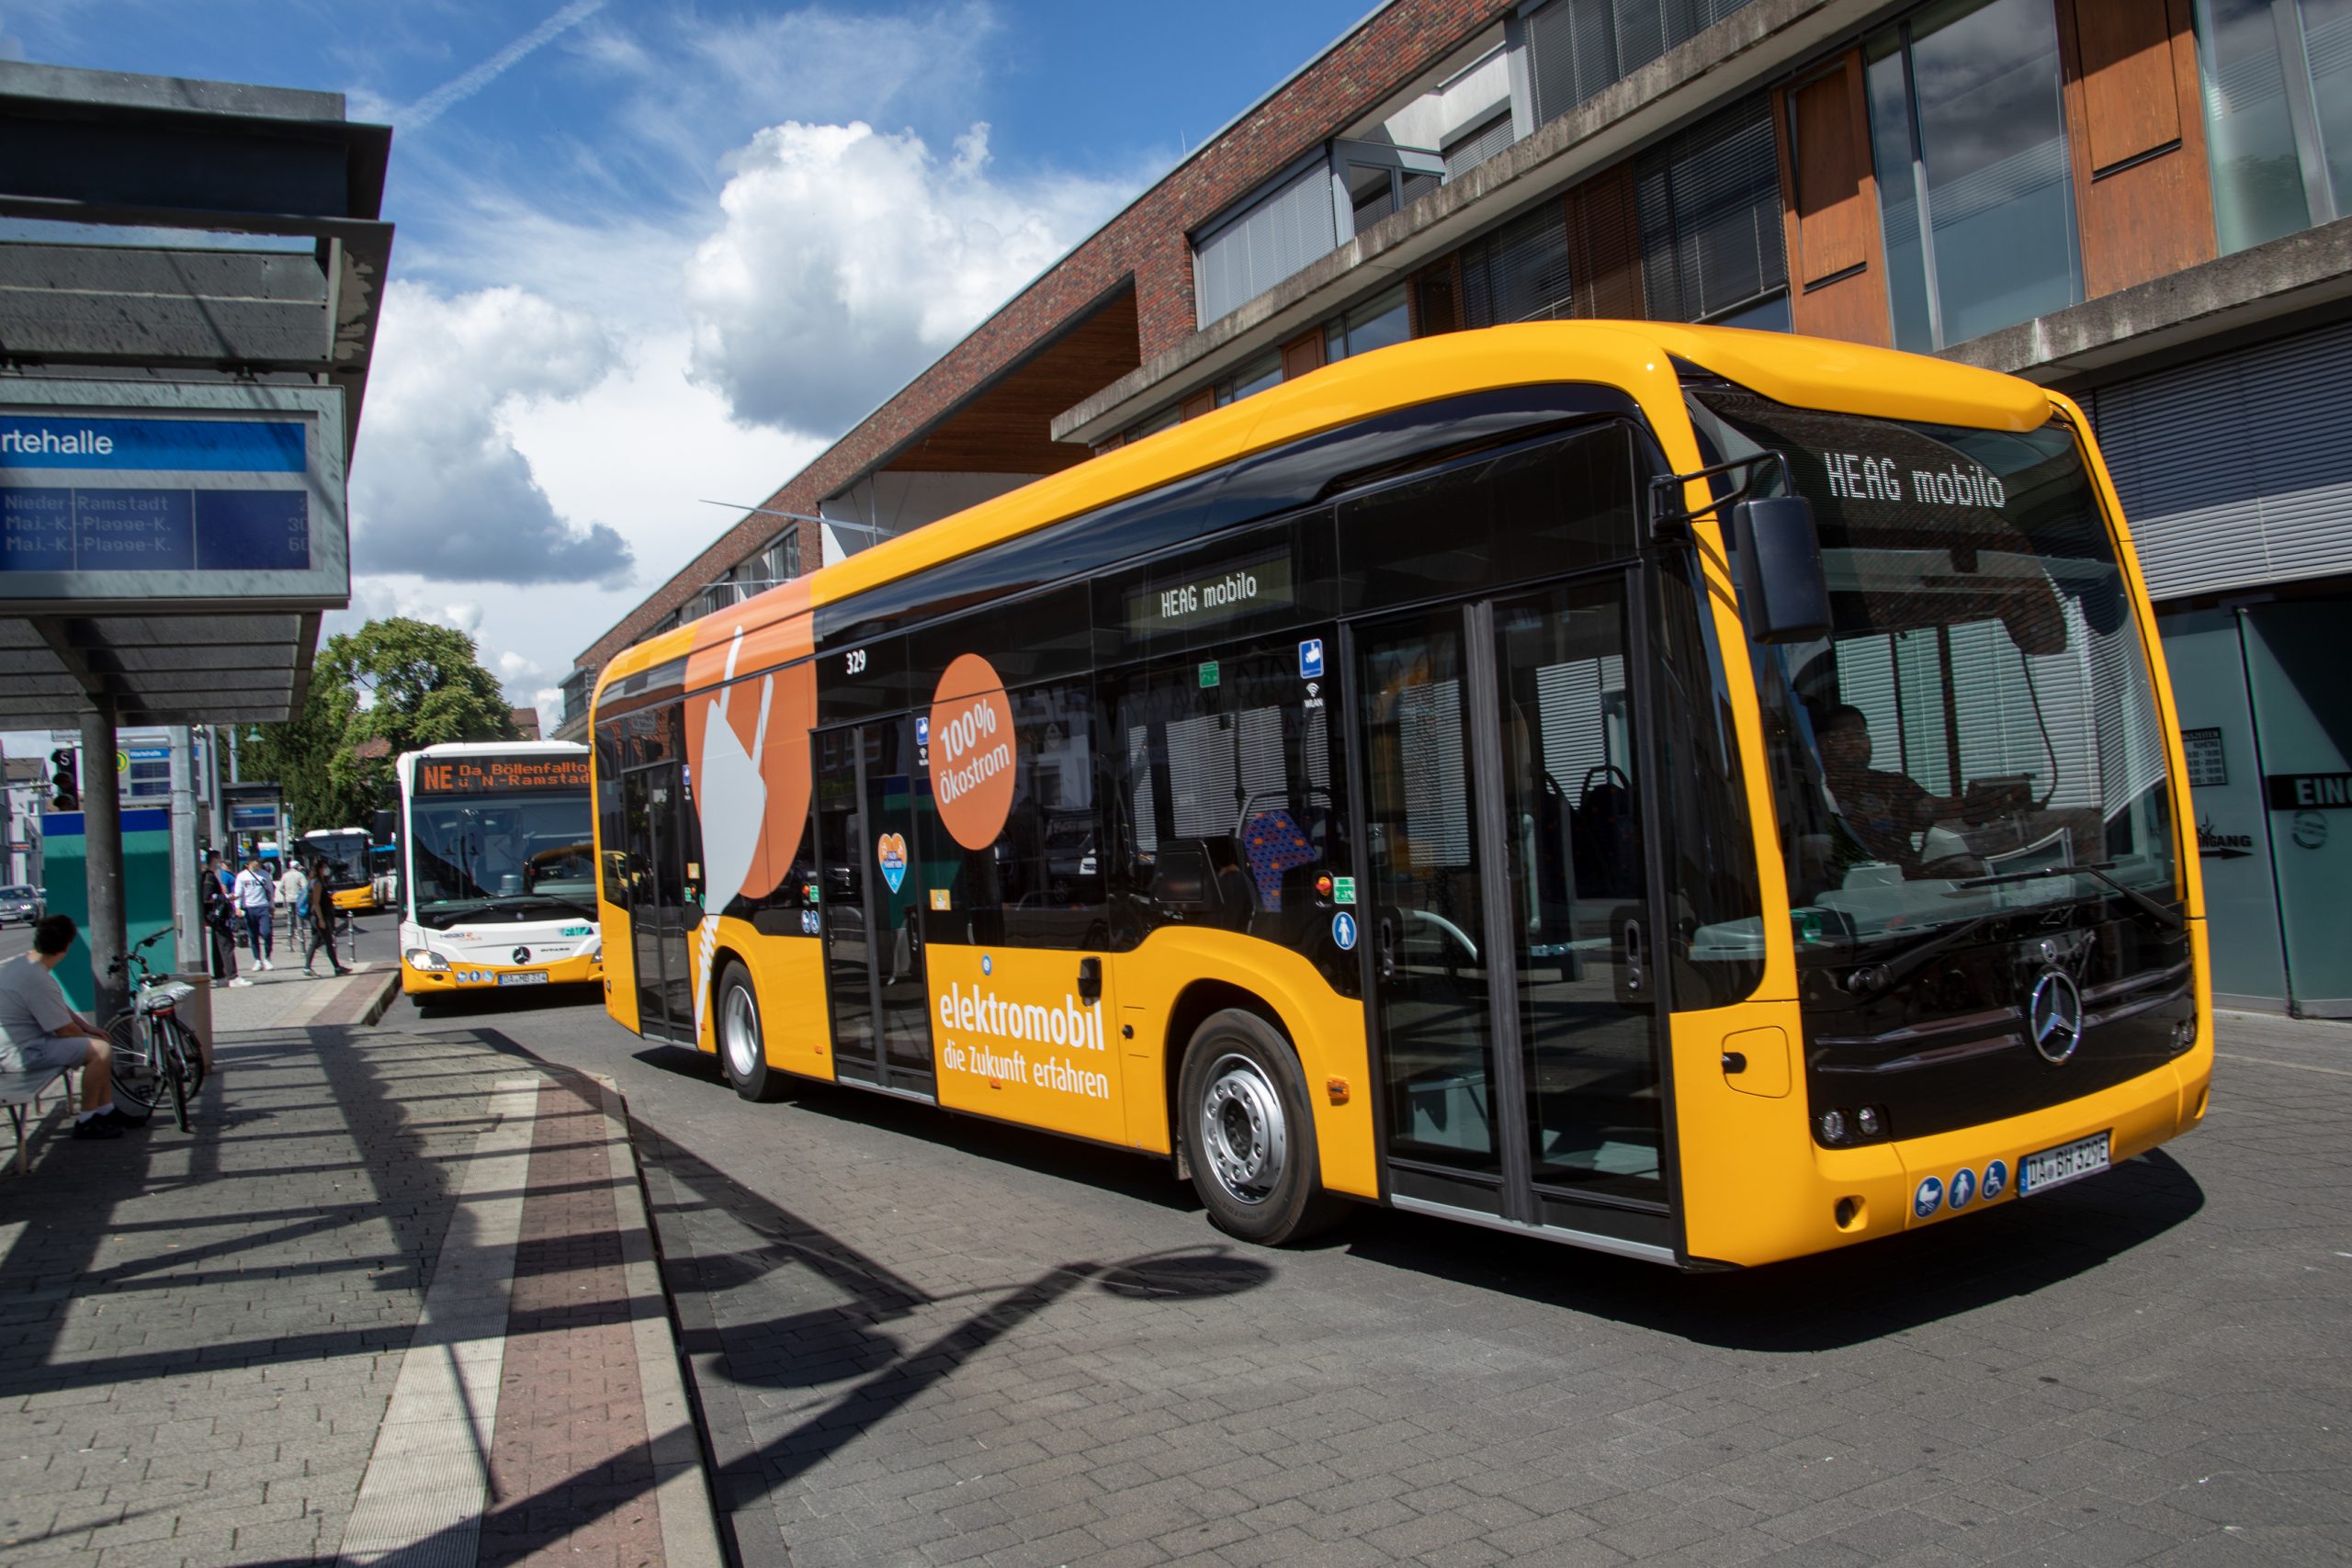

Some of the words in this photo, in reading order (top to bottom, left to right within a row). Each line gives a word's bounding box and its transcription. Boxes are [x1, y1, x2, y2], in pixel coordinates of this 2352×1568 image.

[1, 429, 113, 455] rtehalle
[1824, 453, 1901, 501] HEAG
[1912, 464, 2006, 508] mobilo
[1160, 585, 1198, 618] HEAG
[1204, 571, 1258, 608] mobilo
[845, 649, 866, 675] 329
[940, 698, 997, 762] 100%
[424, 764, 453, 790] NE
[940, 743, 1011, 805] Ökostrom
[940, 982, 1105, 1051] elektromobil
[944, 1039, 966, 1071] die
[968, 1045, 1028, 1084] Zukunft
[1033, 1056, 1109, 1100] erfahren
[2028, 1157, 2047, 1186] DA
[2057, 1148, 2074, 1176] BH
[2076, 1137, 2107, 1170] 329E
